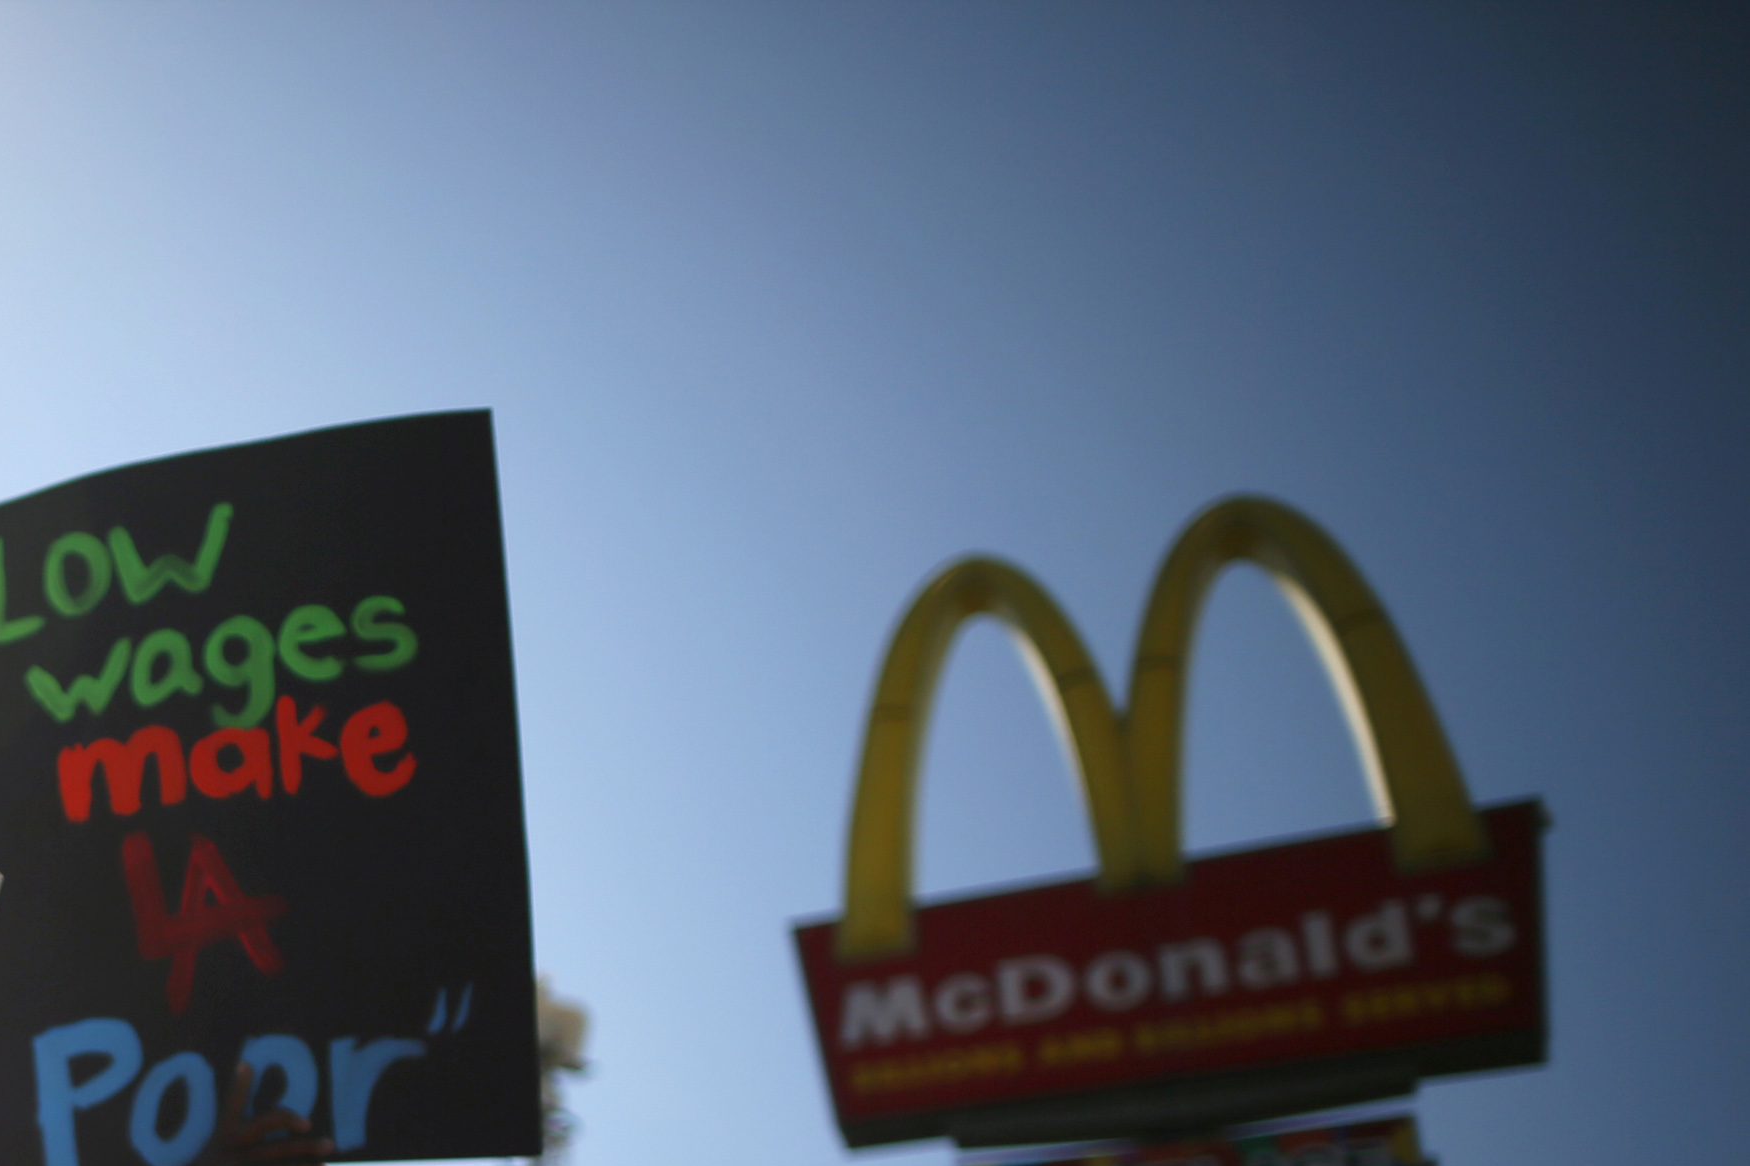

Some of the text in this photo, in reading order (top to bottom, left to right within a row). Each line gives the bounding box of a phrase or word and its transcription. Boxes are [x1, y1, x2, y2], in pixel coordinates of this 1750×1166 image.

[24, 595, 418, 728] wages
[57, 695, 417, 822] make
[122, 832, 288, 1013] LA
[841, 897, 1515, 1048] McDonald's
